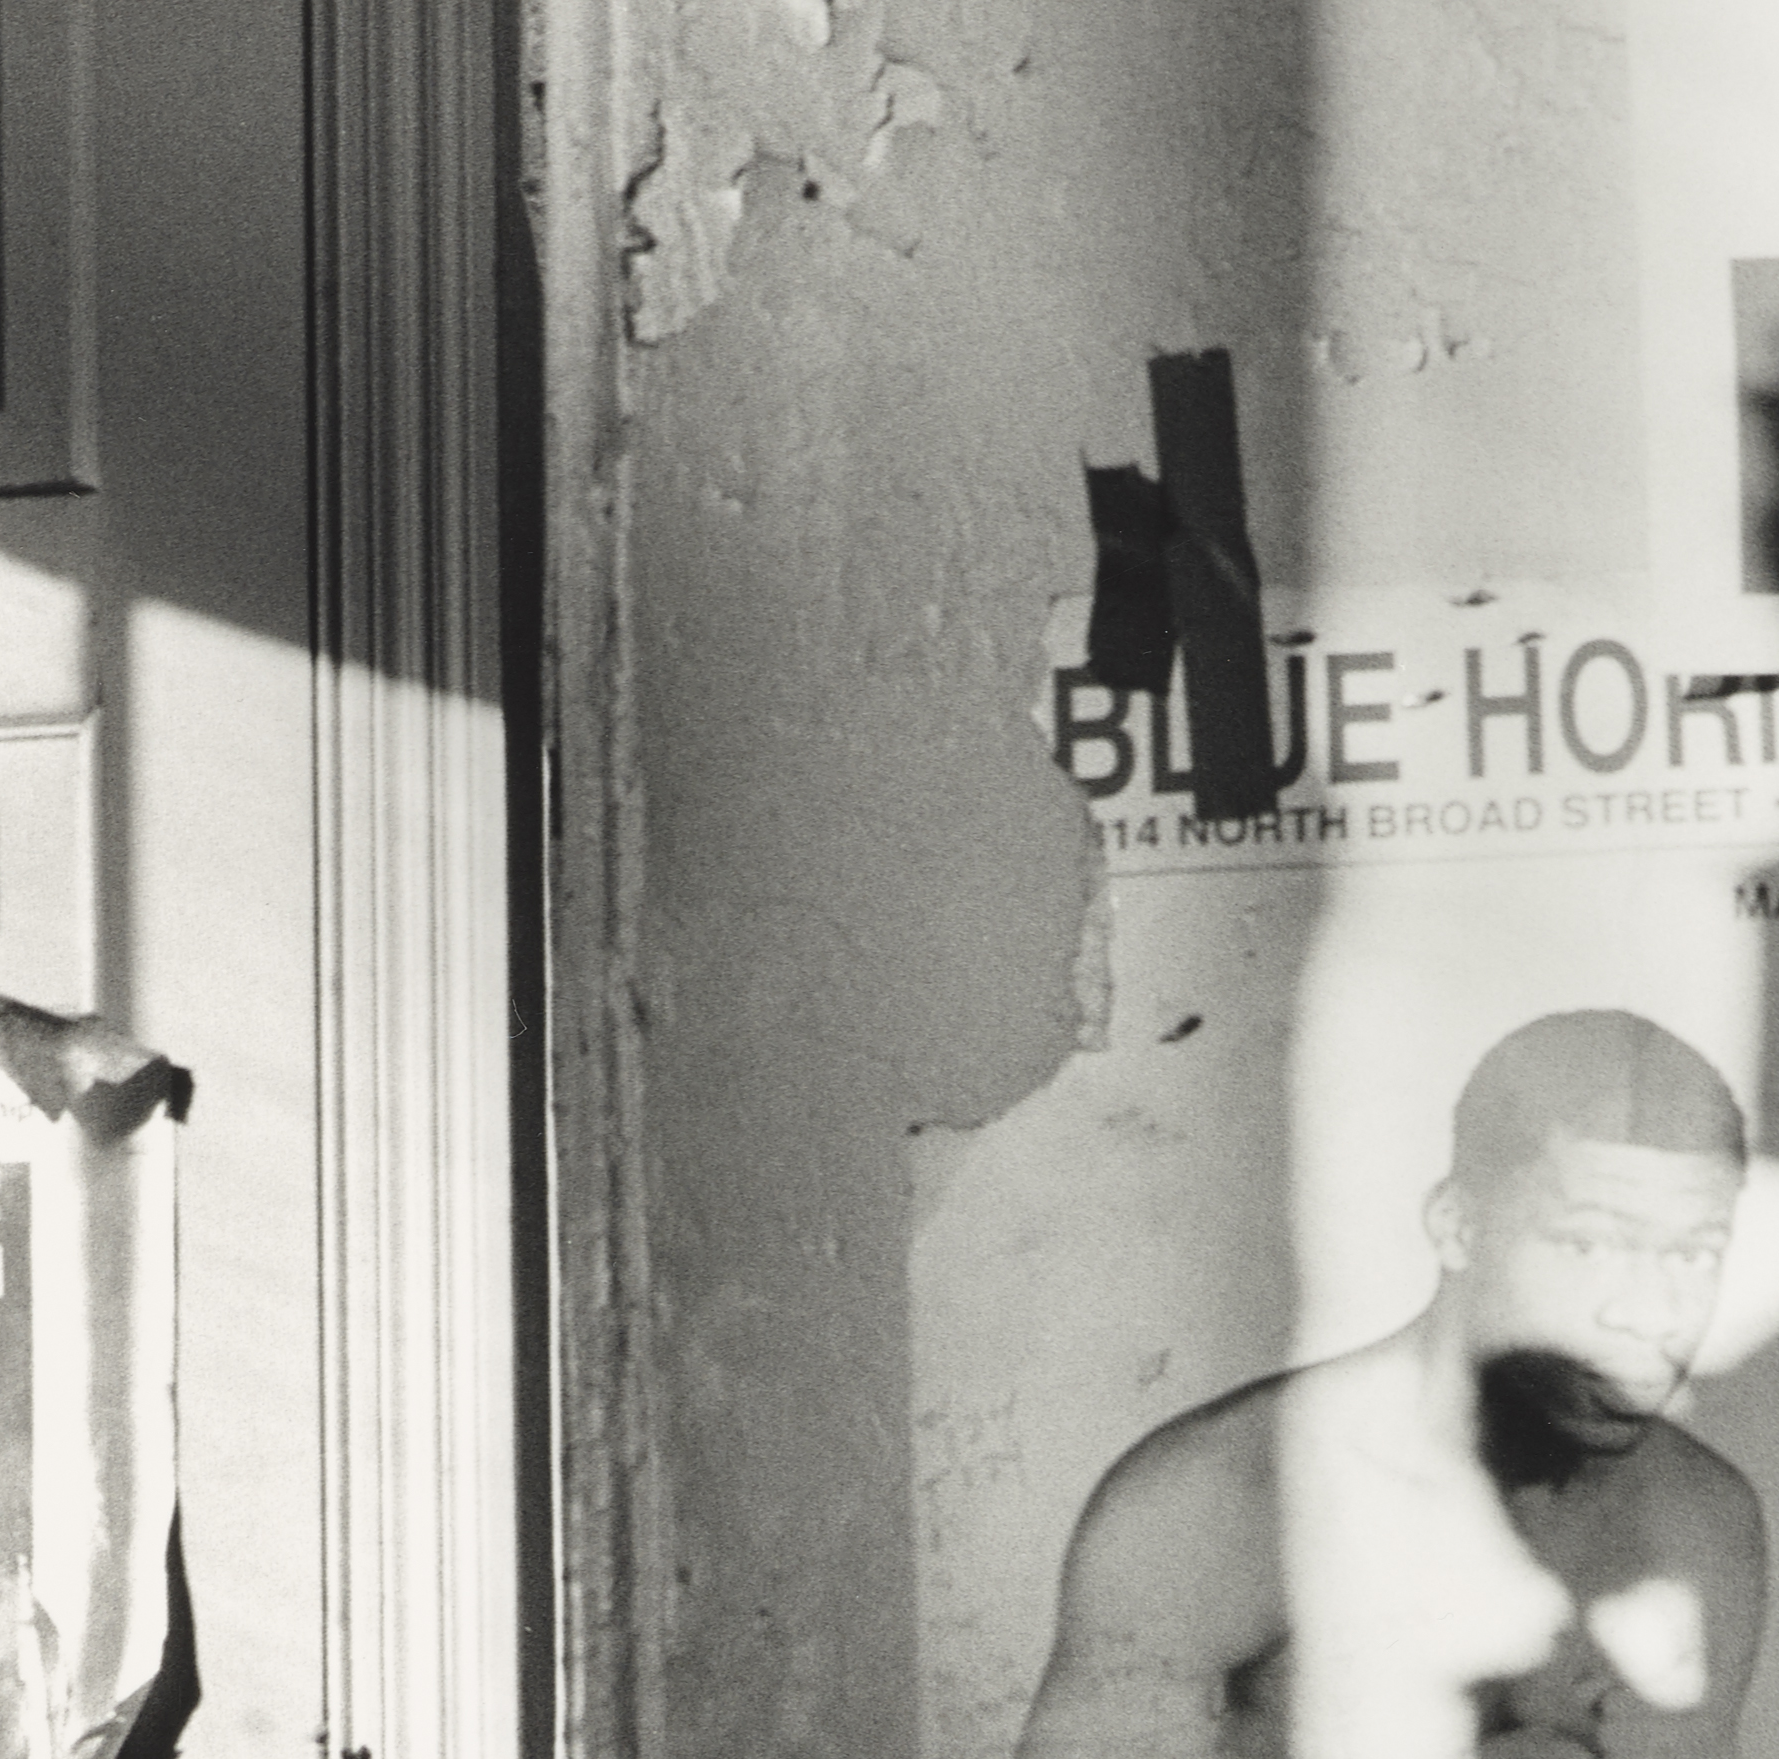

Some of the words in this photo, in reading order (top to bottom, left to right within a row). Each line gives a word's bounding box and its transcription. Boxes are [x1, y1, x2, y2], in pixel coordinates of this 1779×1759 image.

[1178, 802, 1350, 850] NORTH
[1368, 796, 1546, 840] BROAD
[1563, 786, 1752, 832] STREET
